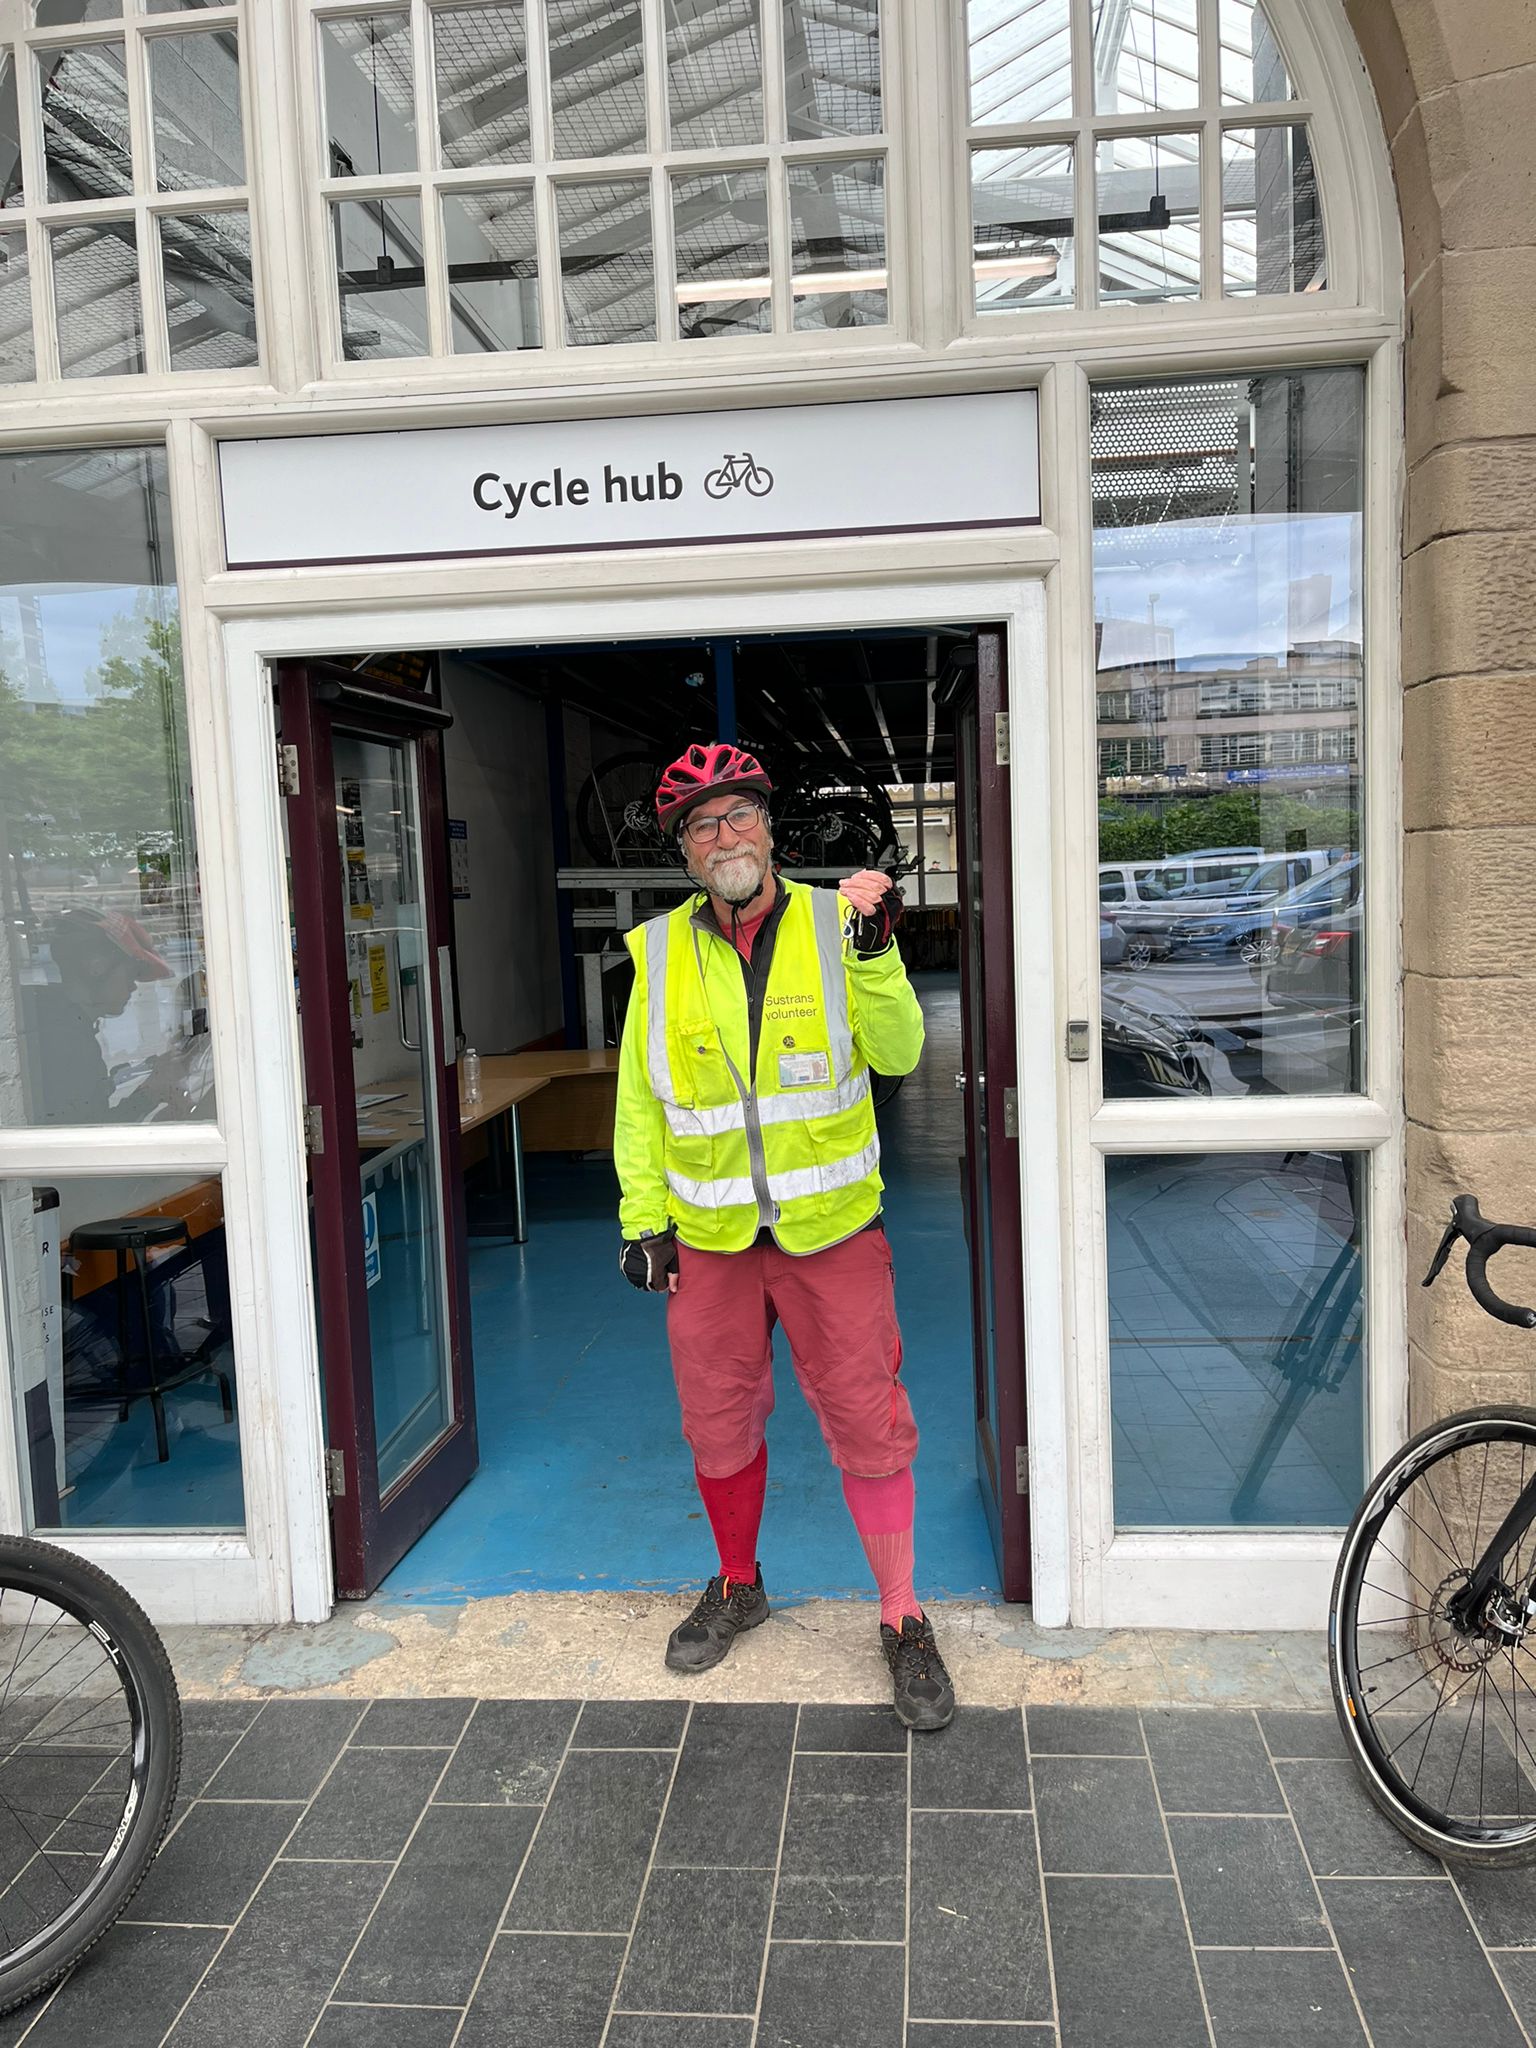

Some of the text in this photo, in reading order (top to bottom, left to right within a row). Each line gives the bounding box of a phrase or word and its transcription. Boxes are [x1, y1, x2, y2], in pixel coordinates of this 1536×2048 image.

[473, 461, 683, 519] Cycle hub
[765, 994, 815, 1007] Sustrans
[765, 1007, 818, 1021] volunteer
[108, 1796, 137, 1855] HALO
